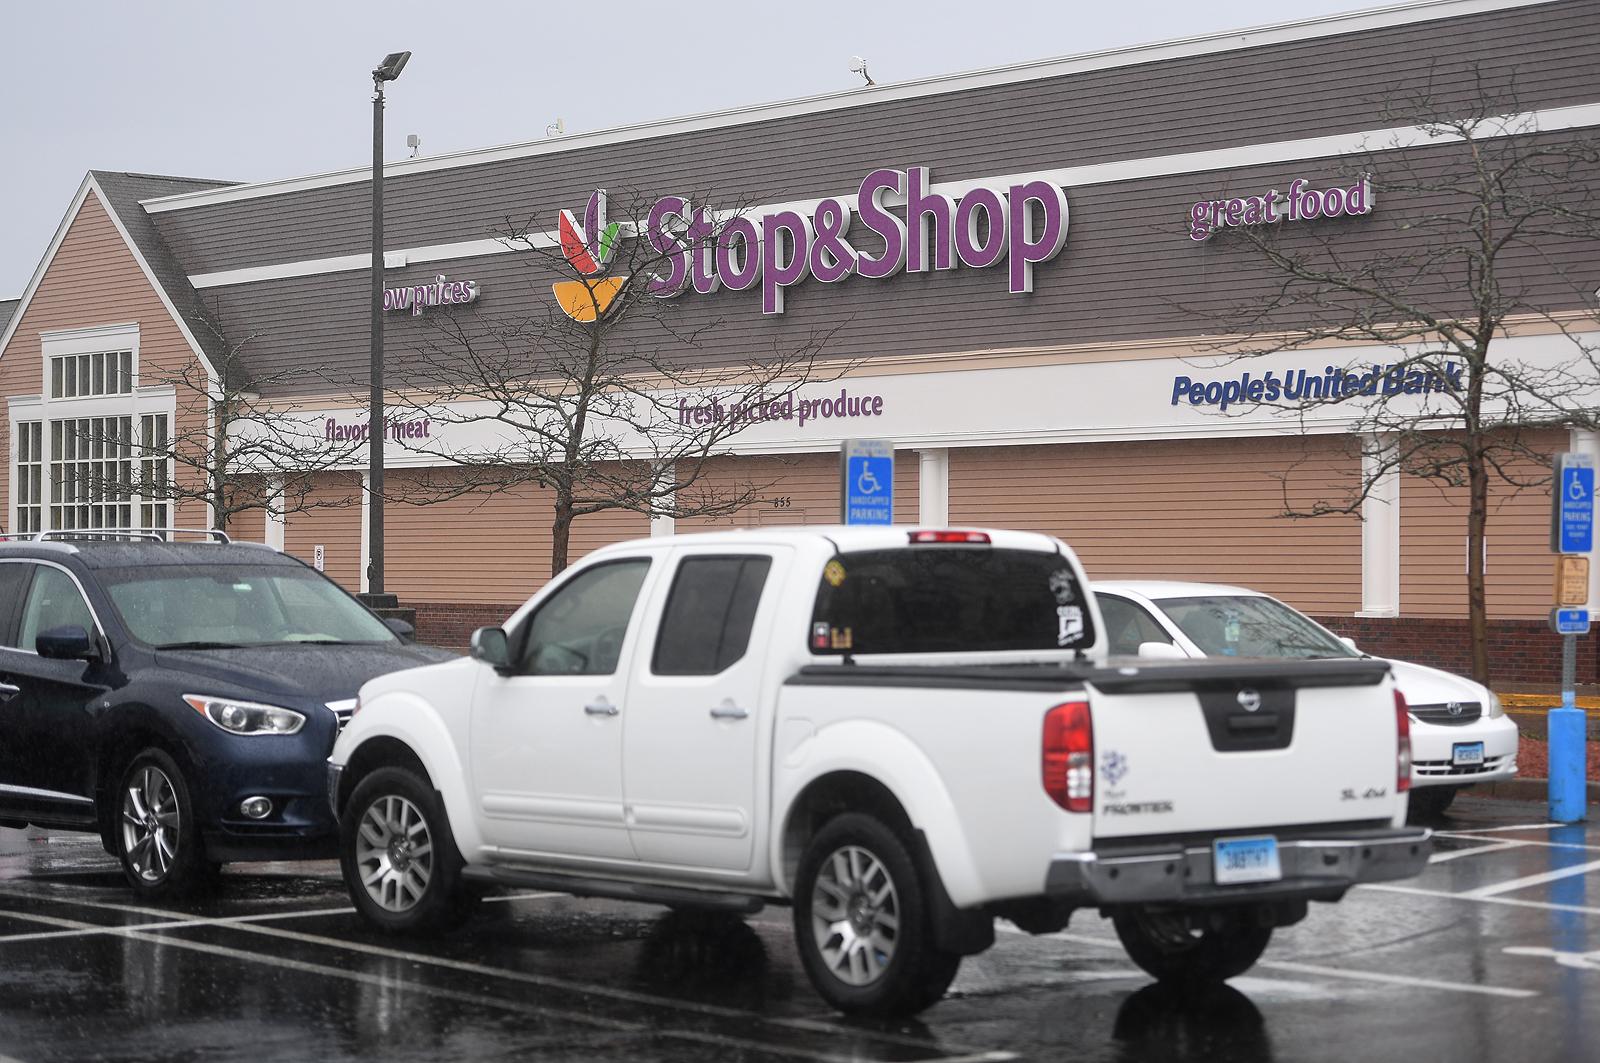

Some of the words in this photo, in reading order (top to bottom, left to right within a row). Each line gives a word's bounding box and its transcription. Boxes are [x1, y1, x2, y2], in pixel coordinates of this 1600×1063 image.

[1190, 189, 1281, 241] great
[1287, 172, 1373, 221] food
[647, 166, 1070, 315] Stop&Shop
[382, 285, 409, 311] ow
[412, 275, 475, 316] prices
[1171, 371, 1281, 411] People's
[1284, 365, 1381, 400] United
[1382, 361, 1465, 395] Bank
[325, 416, 388, 442] flavorl
[391, 417, 430, 440] meat
[678, 397, 725, 426] fresh
[730, 392, 794, 430] picked
[799, 388, 884, 427] produce
[773, 496, 792, 508] 855
[850, 508, 889, 520] PARKING
